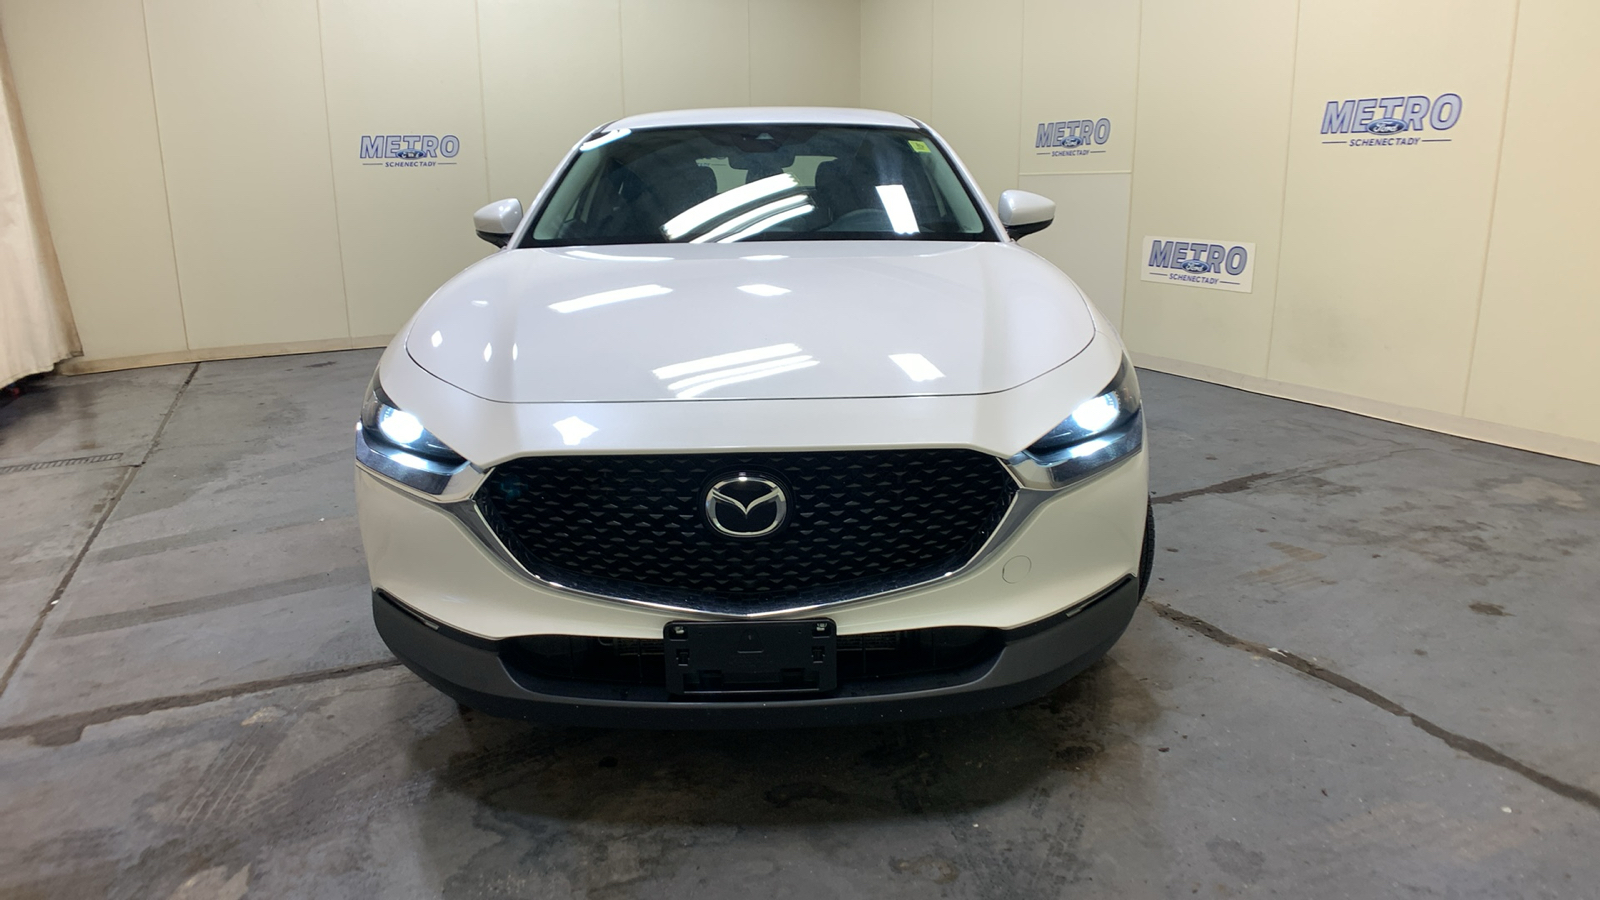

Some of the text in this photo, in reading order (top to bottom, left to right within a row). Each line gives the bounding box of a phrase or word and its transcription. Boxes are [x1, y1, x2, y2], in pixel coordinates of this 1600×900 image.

[1320, 93, 1463, 134] METRO
[1035, 118, 1111, 148] METRO
[1349, 137, 1421, 147] SCHENECTADY
[360, 135, 460, 158] METRO
[1148, 239, 1248, 276] METRO
[1168, 273, 1220, 285] SCHENECTADY
